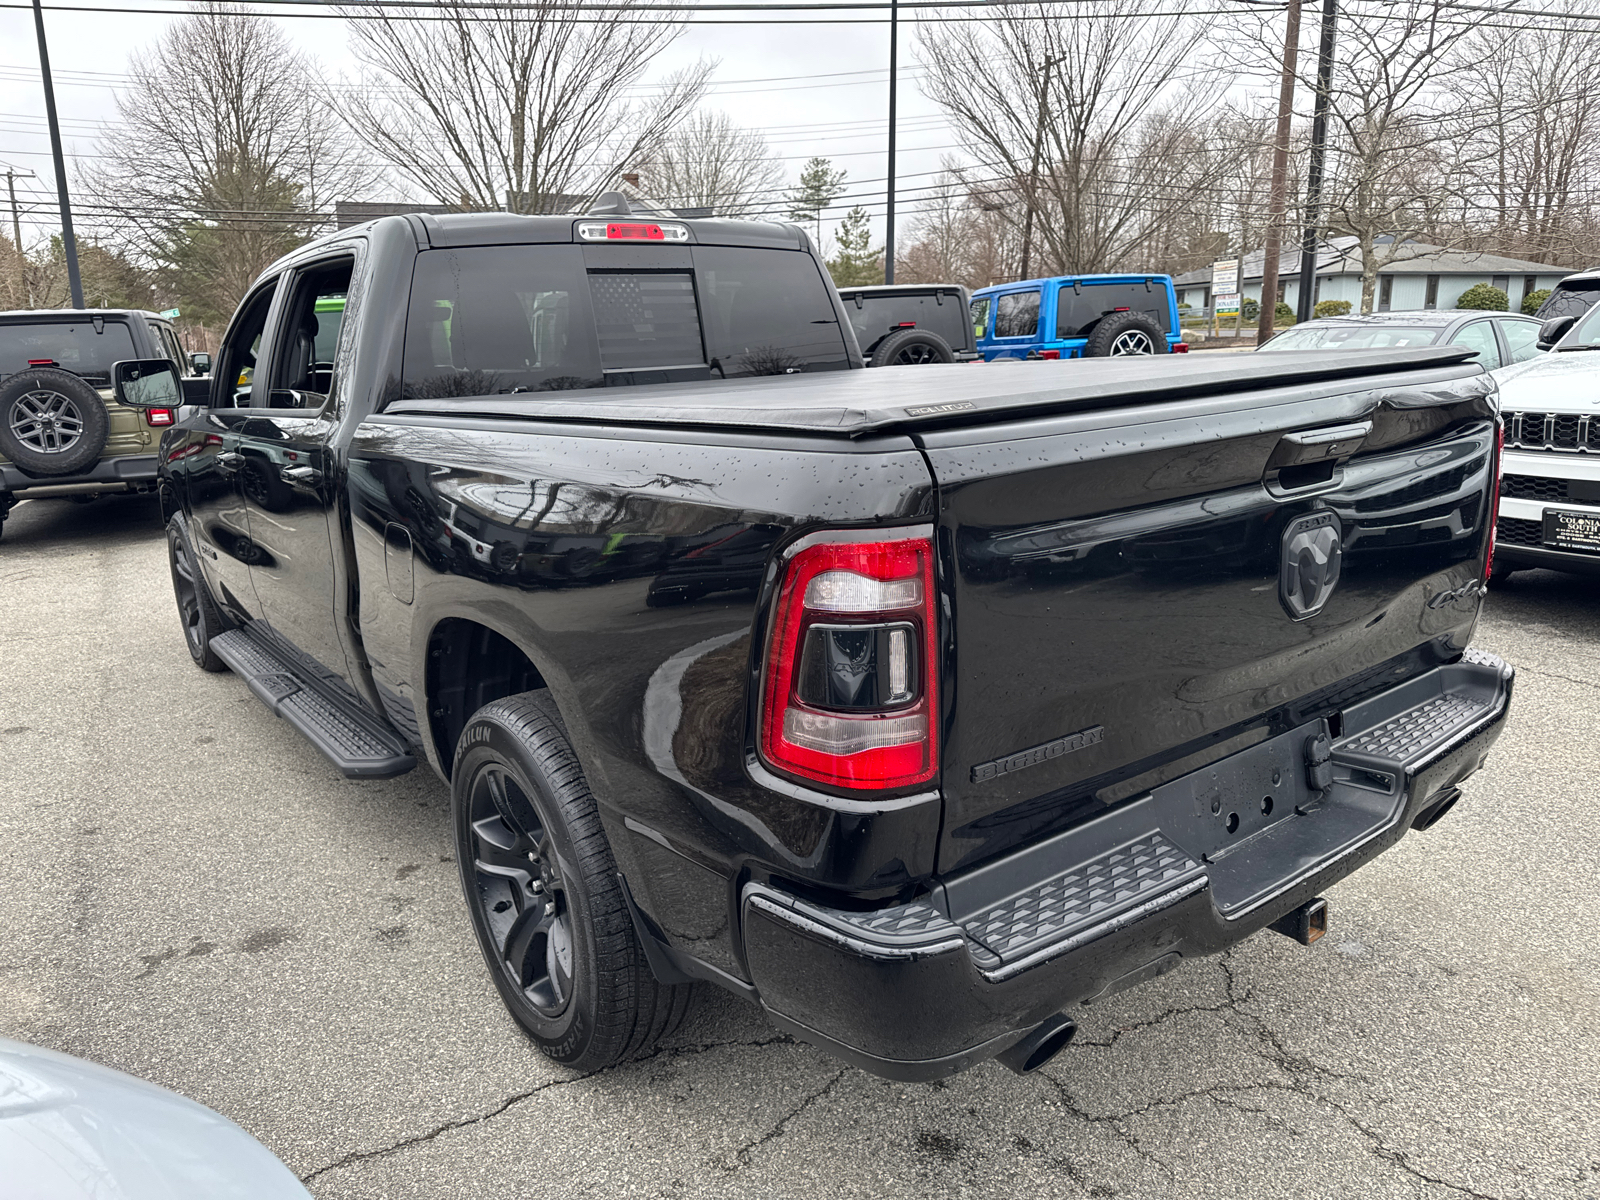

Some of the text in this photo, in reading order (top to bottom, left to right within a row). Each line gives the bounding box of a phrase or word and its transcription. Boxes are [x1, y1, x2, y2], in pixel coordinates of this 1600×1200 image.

[1298, 514, 1332, 530] RAM
[1567, 524, 1598, 532] SOUTH
[457, 726, 492, 759] SAILUN
[971, 724, 1105, 784] BIGHORN
[542, 1012, 584, 1058] ATREZZO
